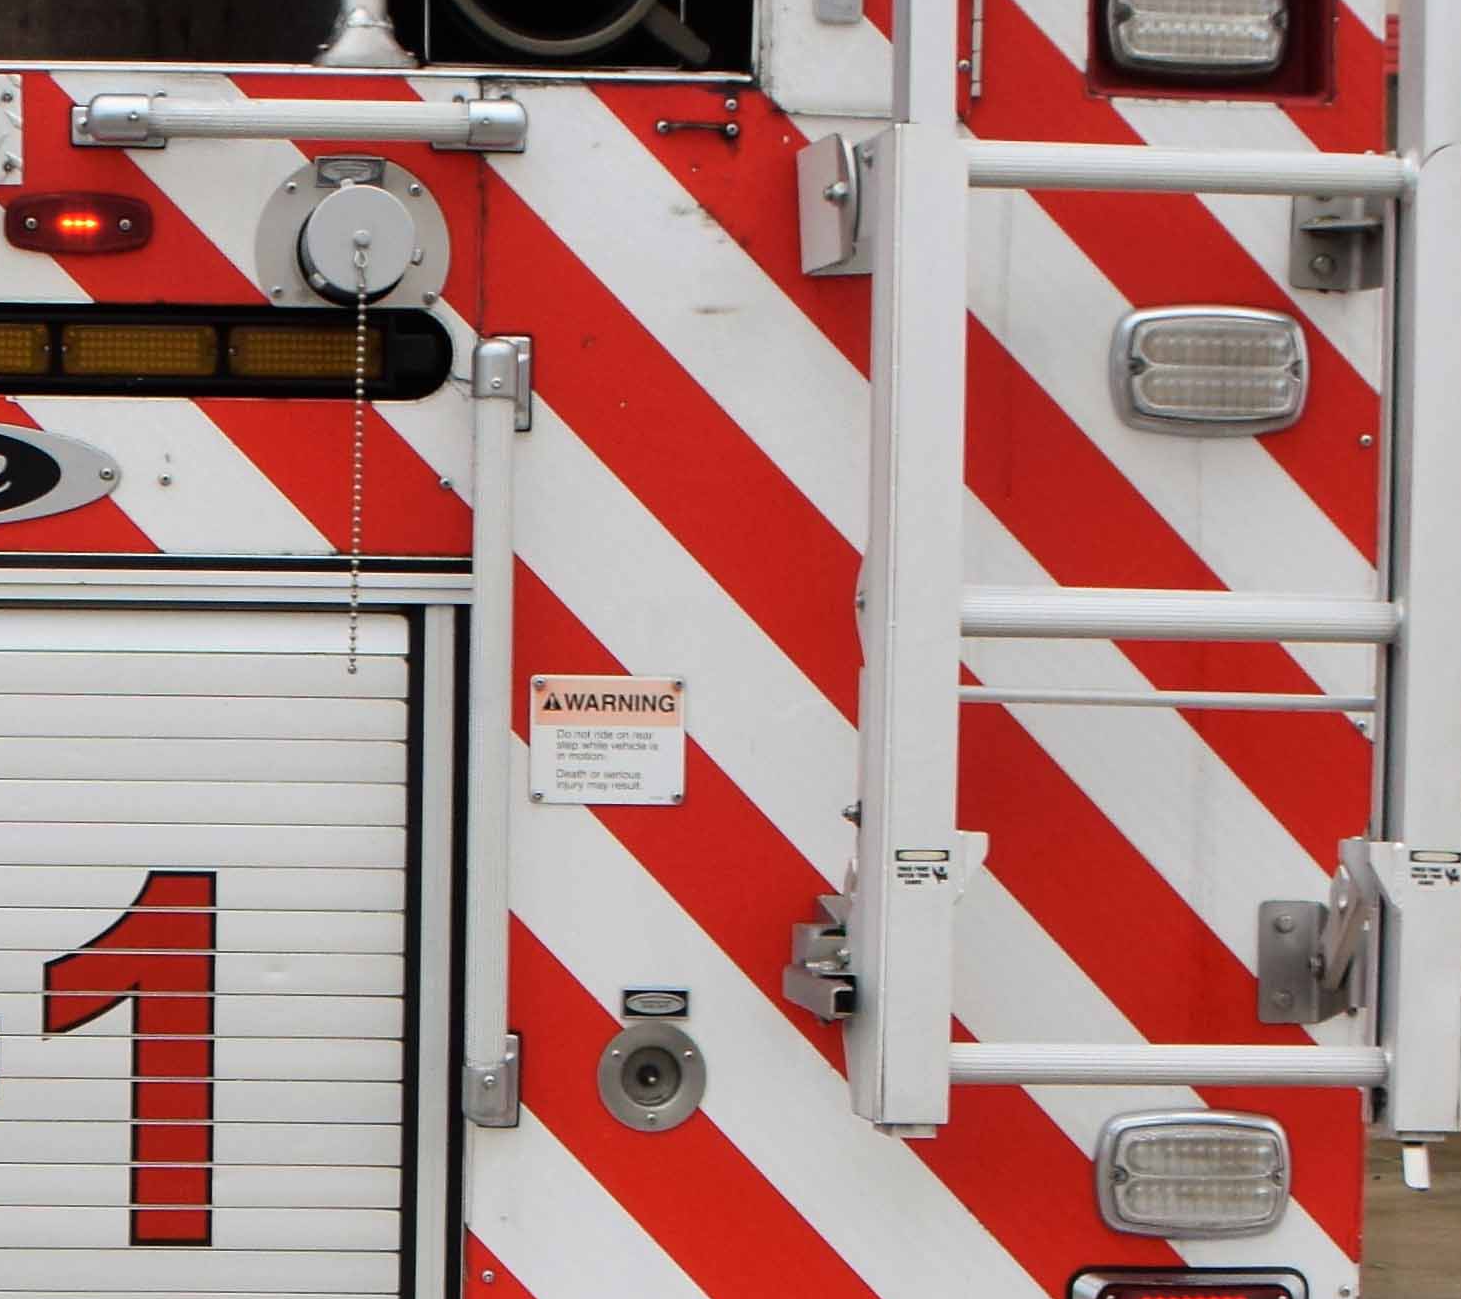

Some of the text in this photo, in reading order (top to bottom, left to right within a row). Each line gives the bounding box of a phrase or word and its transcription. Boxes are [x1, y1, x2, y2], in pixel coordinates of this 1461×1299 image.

[563, 693, 676, 713] WARNING
[556, 729, 572, 739] Do
[556, 769, 586, 779] Death
